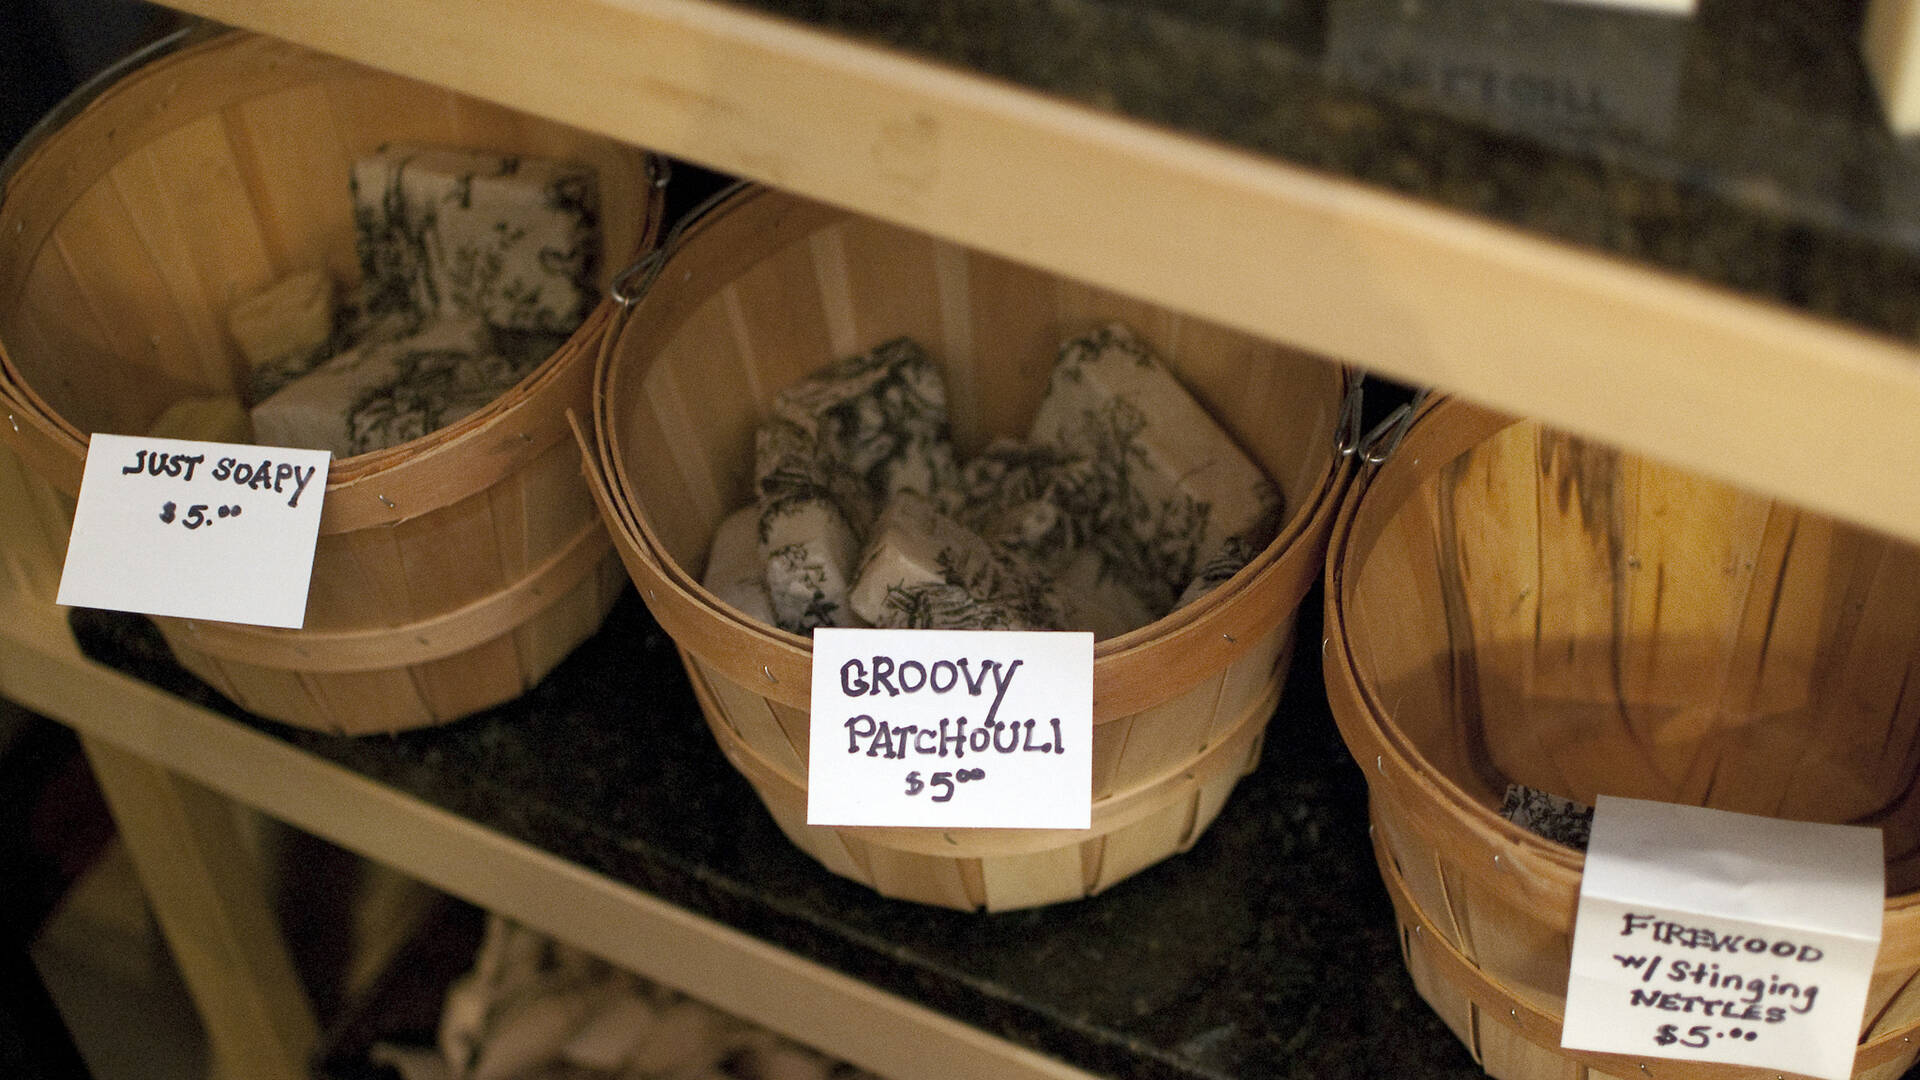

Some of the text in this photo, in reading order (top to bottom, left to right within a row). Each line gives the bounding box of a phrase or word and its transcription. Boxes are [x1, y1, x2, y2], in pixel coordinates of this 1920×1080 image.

[122, 450, 316, 508] JUST SOAPY
[840, 655, 1024, 728] GROOVY
[844, 714, 1065, 760] PATCHOULI
[1620, 912, 1824, 962] FIREWOOD
[1613, 955, 1819, 1014] w/ Stinging
[1630, 989, 1787, 1023] NETTLES
